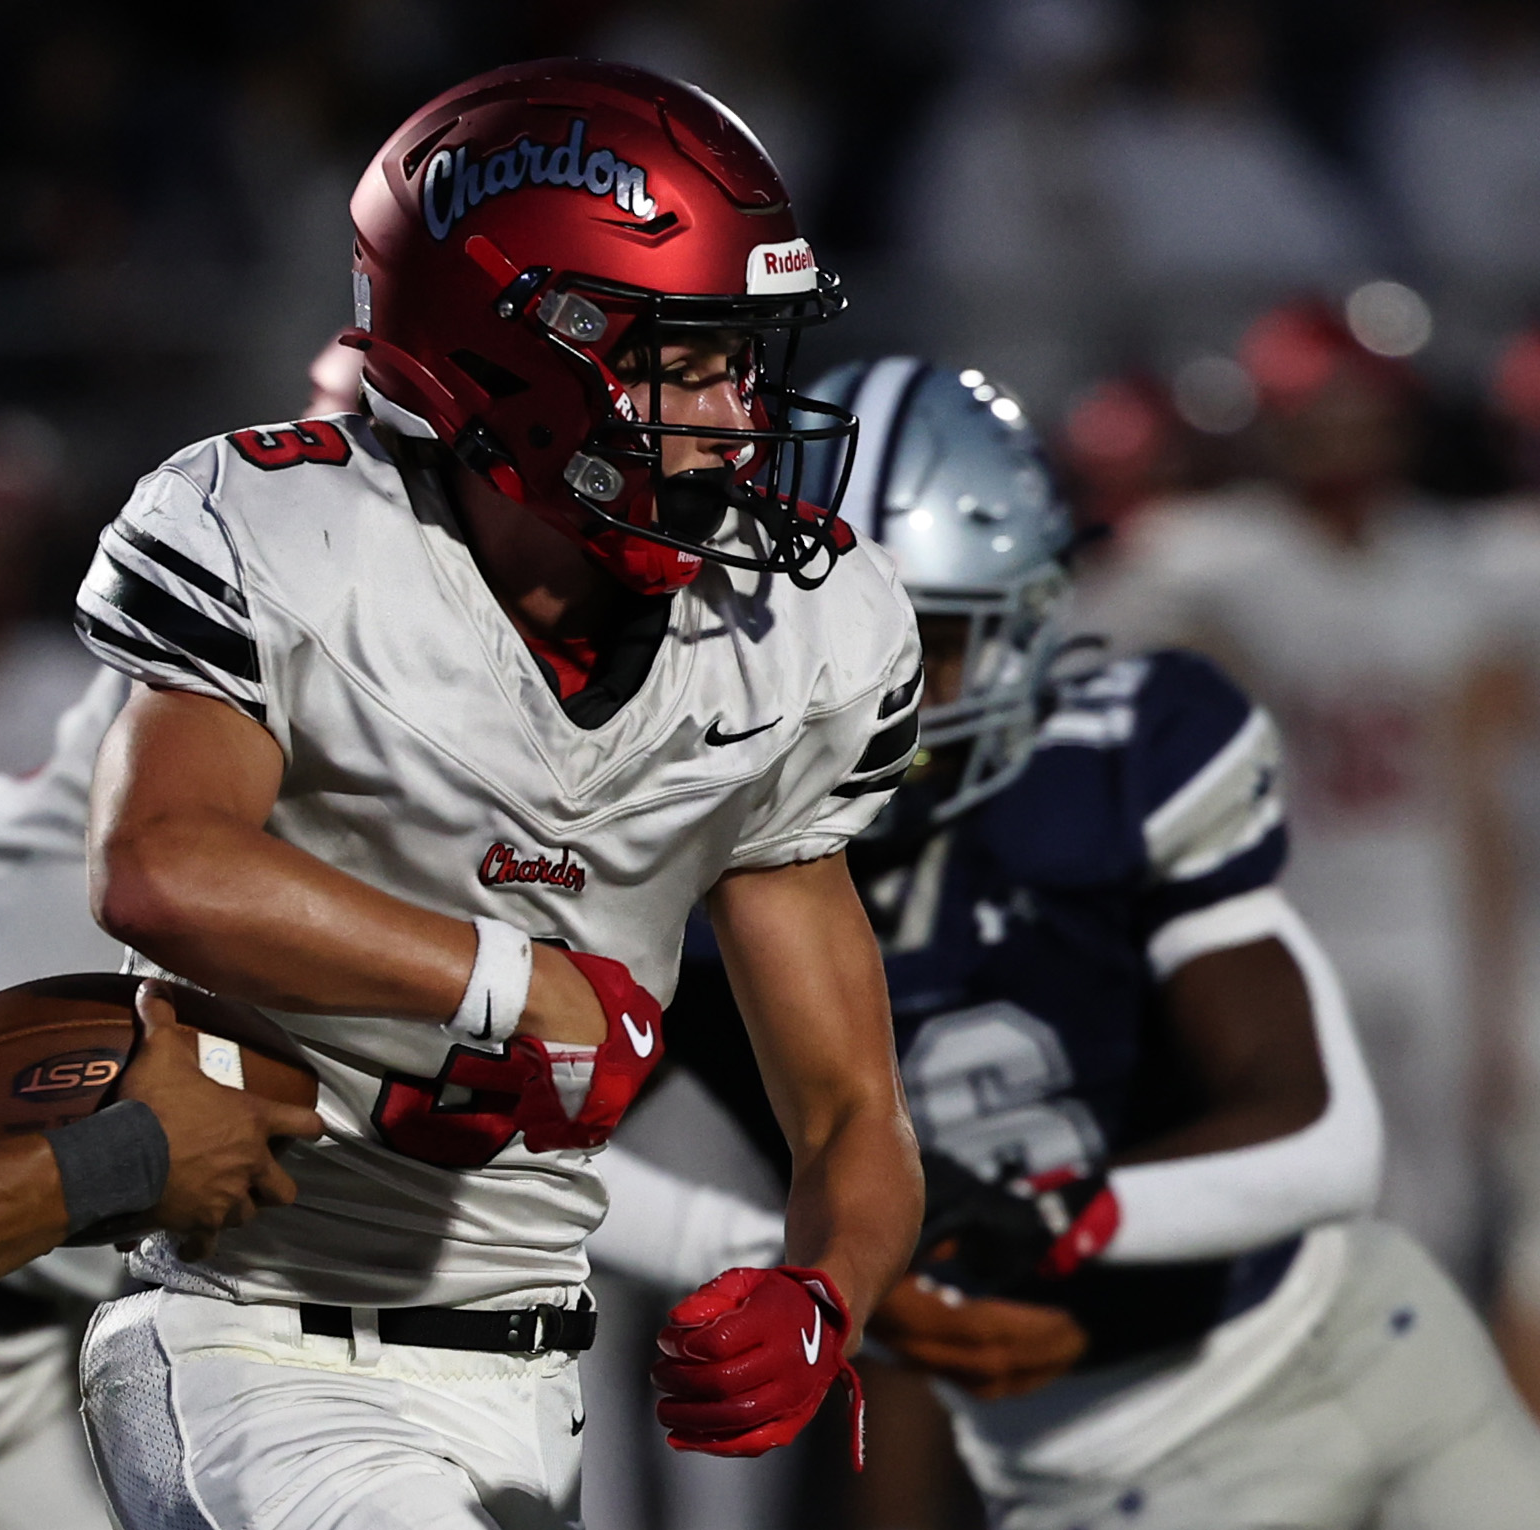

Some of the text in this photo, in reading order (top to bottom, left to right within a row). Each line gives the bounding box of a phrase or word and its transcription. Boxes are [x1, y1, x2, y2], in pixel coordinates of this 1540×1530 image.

[423, 118, 658, 241] Chardon
[764, 246, 814, 275] Riddell
[224, 420, 352, 471] 3
[18, 1060, 120, 1094] GST
